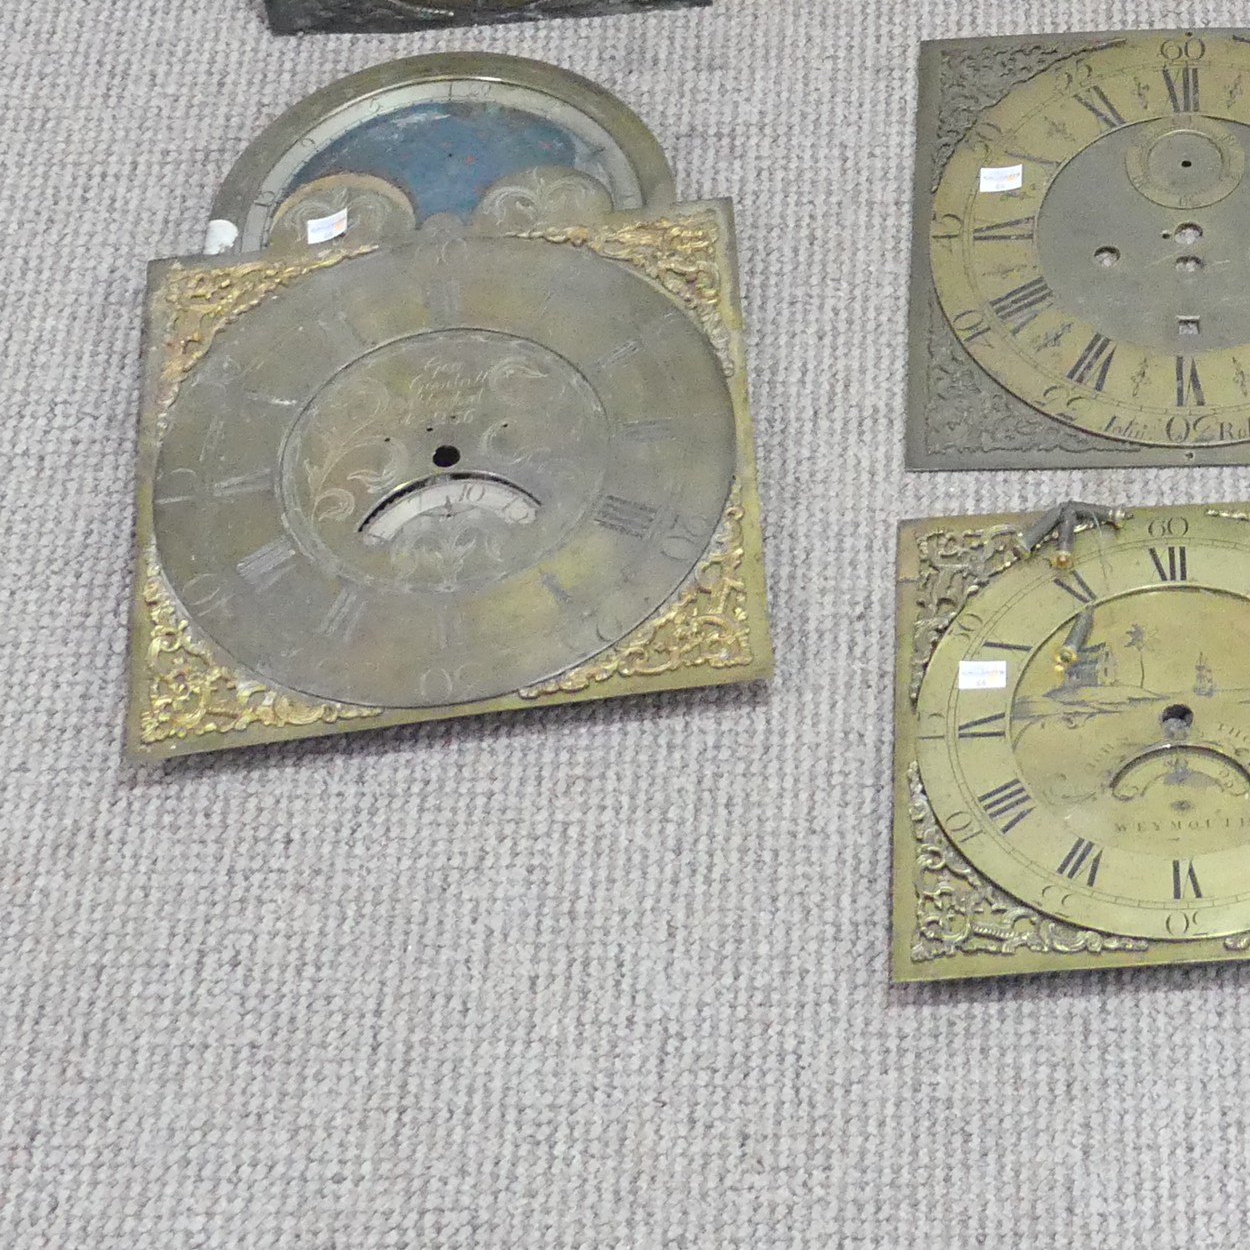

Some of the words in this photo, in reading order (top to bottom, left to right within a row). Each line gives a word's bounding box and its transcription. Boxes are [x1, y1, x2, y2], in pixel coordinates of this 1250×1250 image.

[1071, 84, 1128, 128] XI
[1161, 64, 1201, 114] XII
[971, 214, 1036, 242] IX
[986, 275, 1054, 338] VIII
[1065, 330, 1118, 393] VII
[1173, 354, 1207, 408] VI
[1147, 516, 1191, 539] 60
[1148, 545, 1187, 583] XII
[1052, 568, 1097, 605] XI
[956, 711, 1007, 740] IX
[975, 776, 1037, 835] VIII
[1055, 836, 1104, 889] VII
[1171, 858, 1204, 902] VI
